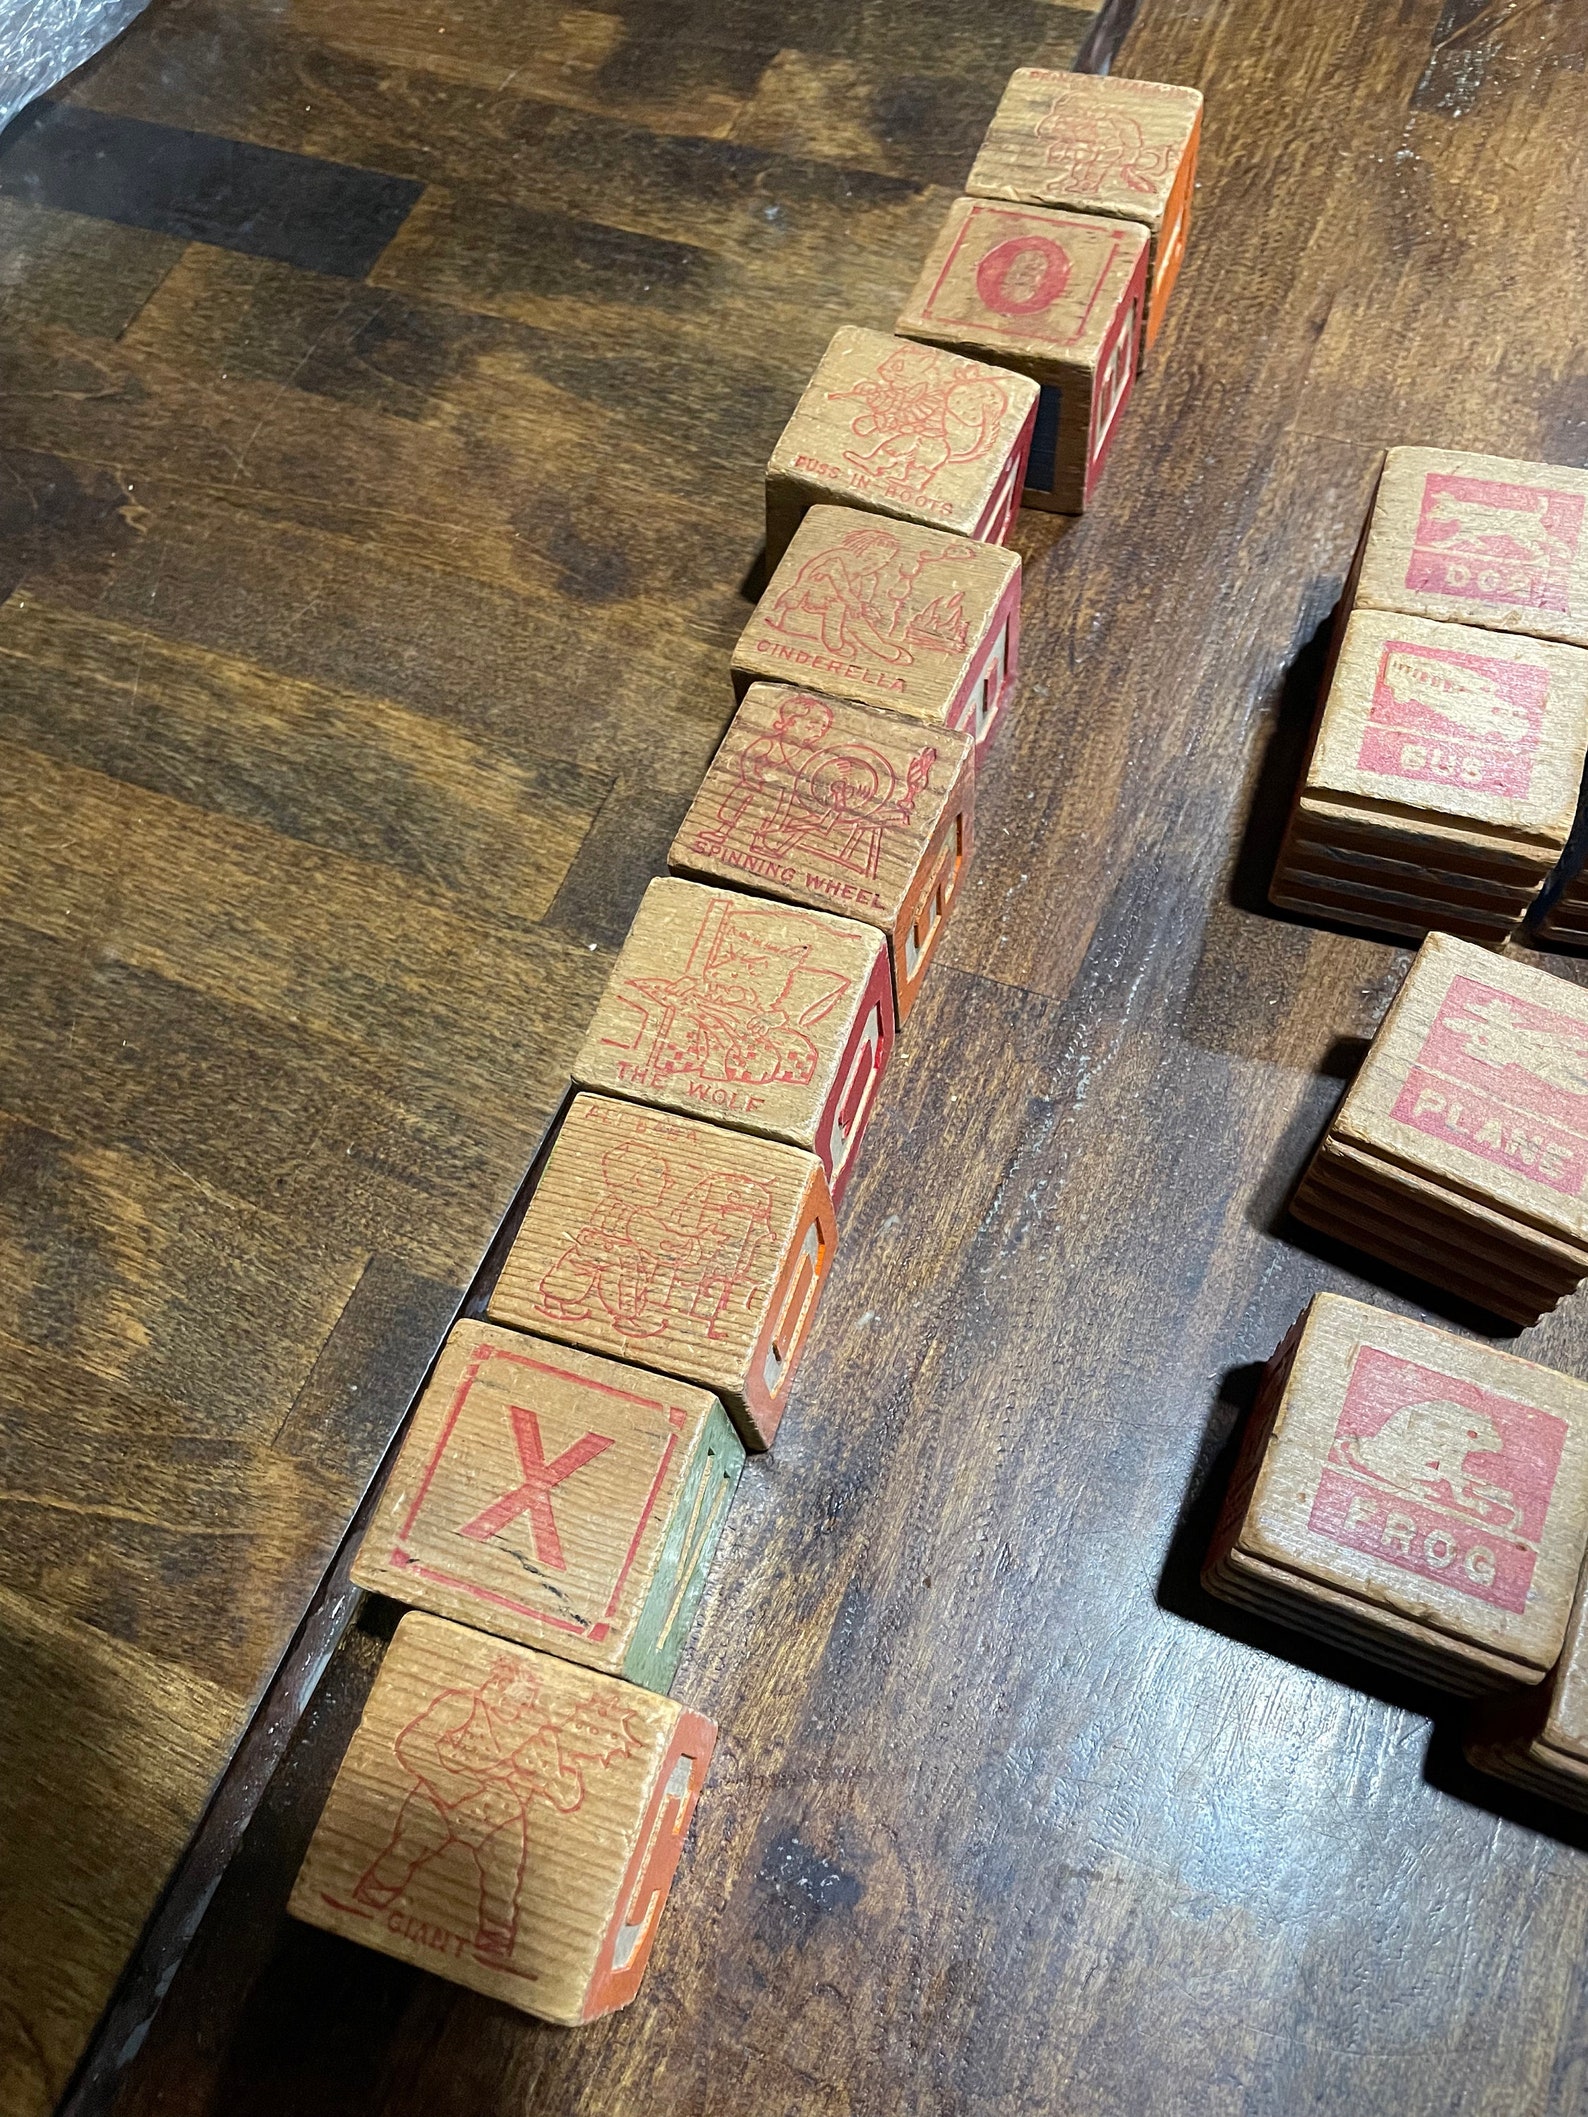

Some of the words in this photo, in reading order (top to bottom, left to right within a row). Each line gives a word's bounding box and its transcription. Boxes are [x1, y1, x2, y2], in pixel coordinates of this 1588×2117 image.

[976, 235, 1072, 316] O
[794, 453, 841, 479] PUSS
[756, 638, 908, 694] CINDERELLA
[1399, 743, 1484, 784] BUS
[692, 838, 796, 884] SPINNING
[804, 872, 886, 910] WHEEL
[616, 1060, 670, 1090] THE
[687, 1080, 766, 1113] WOLF
[1411, 1086, 1576, 1178] PLANE
[459, 1404, 616, 1572] X
[1343, 1496, 1498, 1588] FROG
[387, 1910, 472, 1958] GIANT
